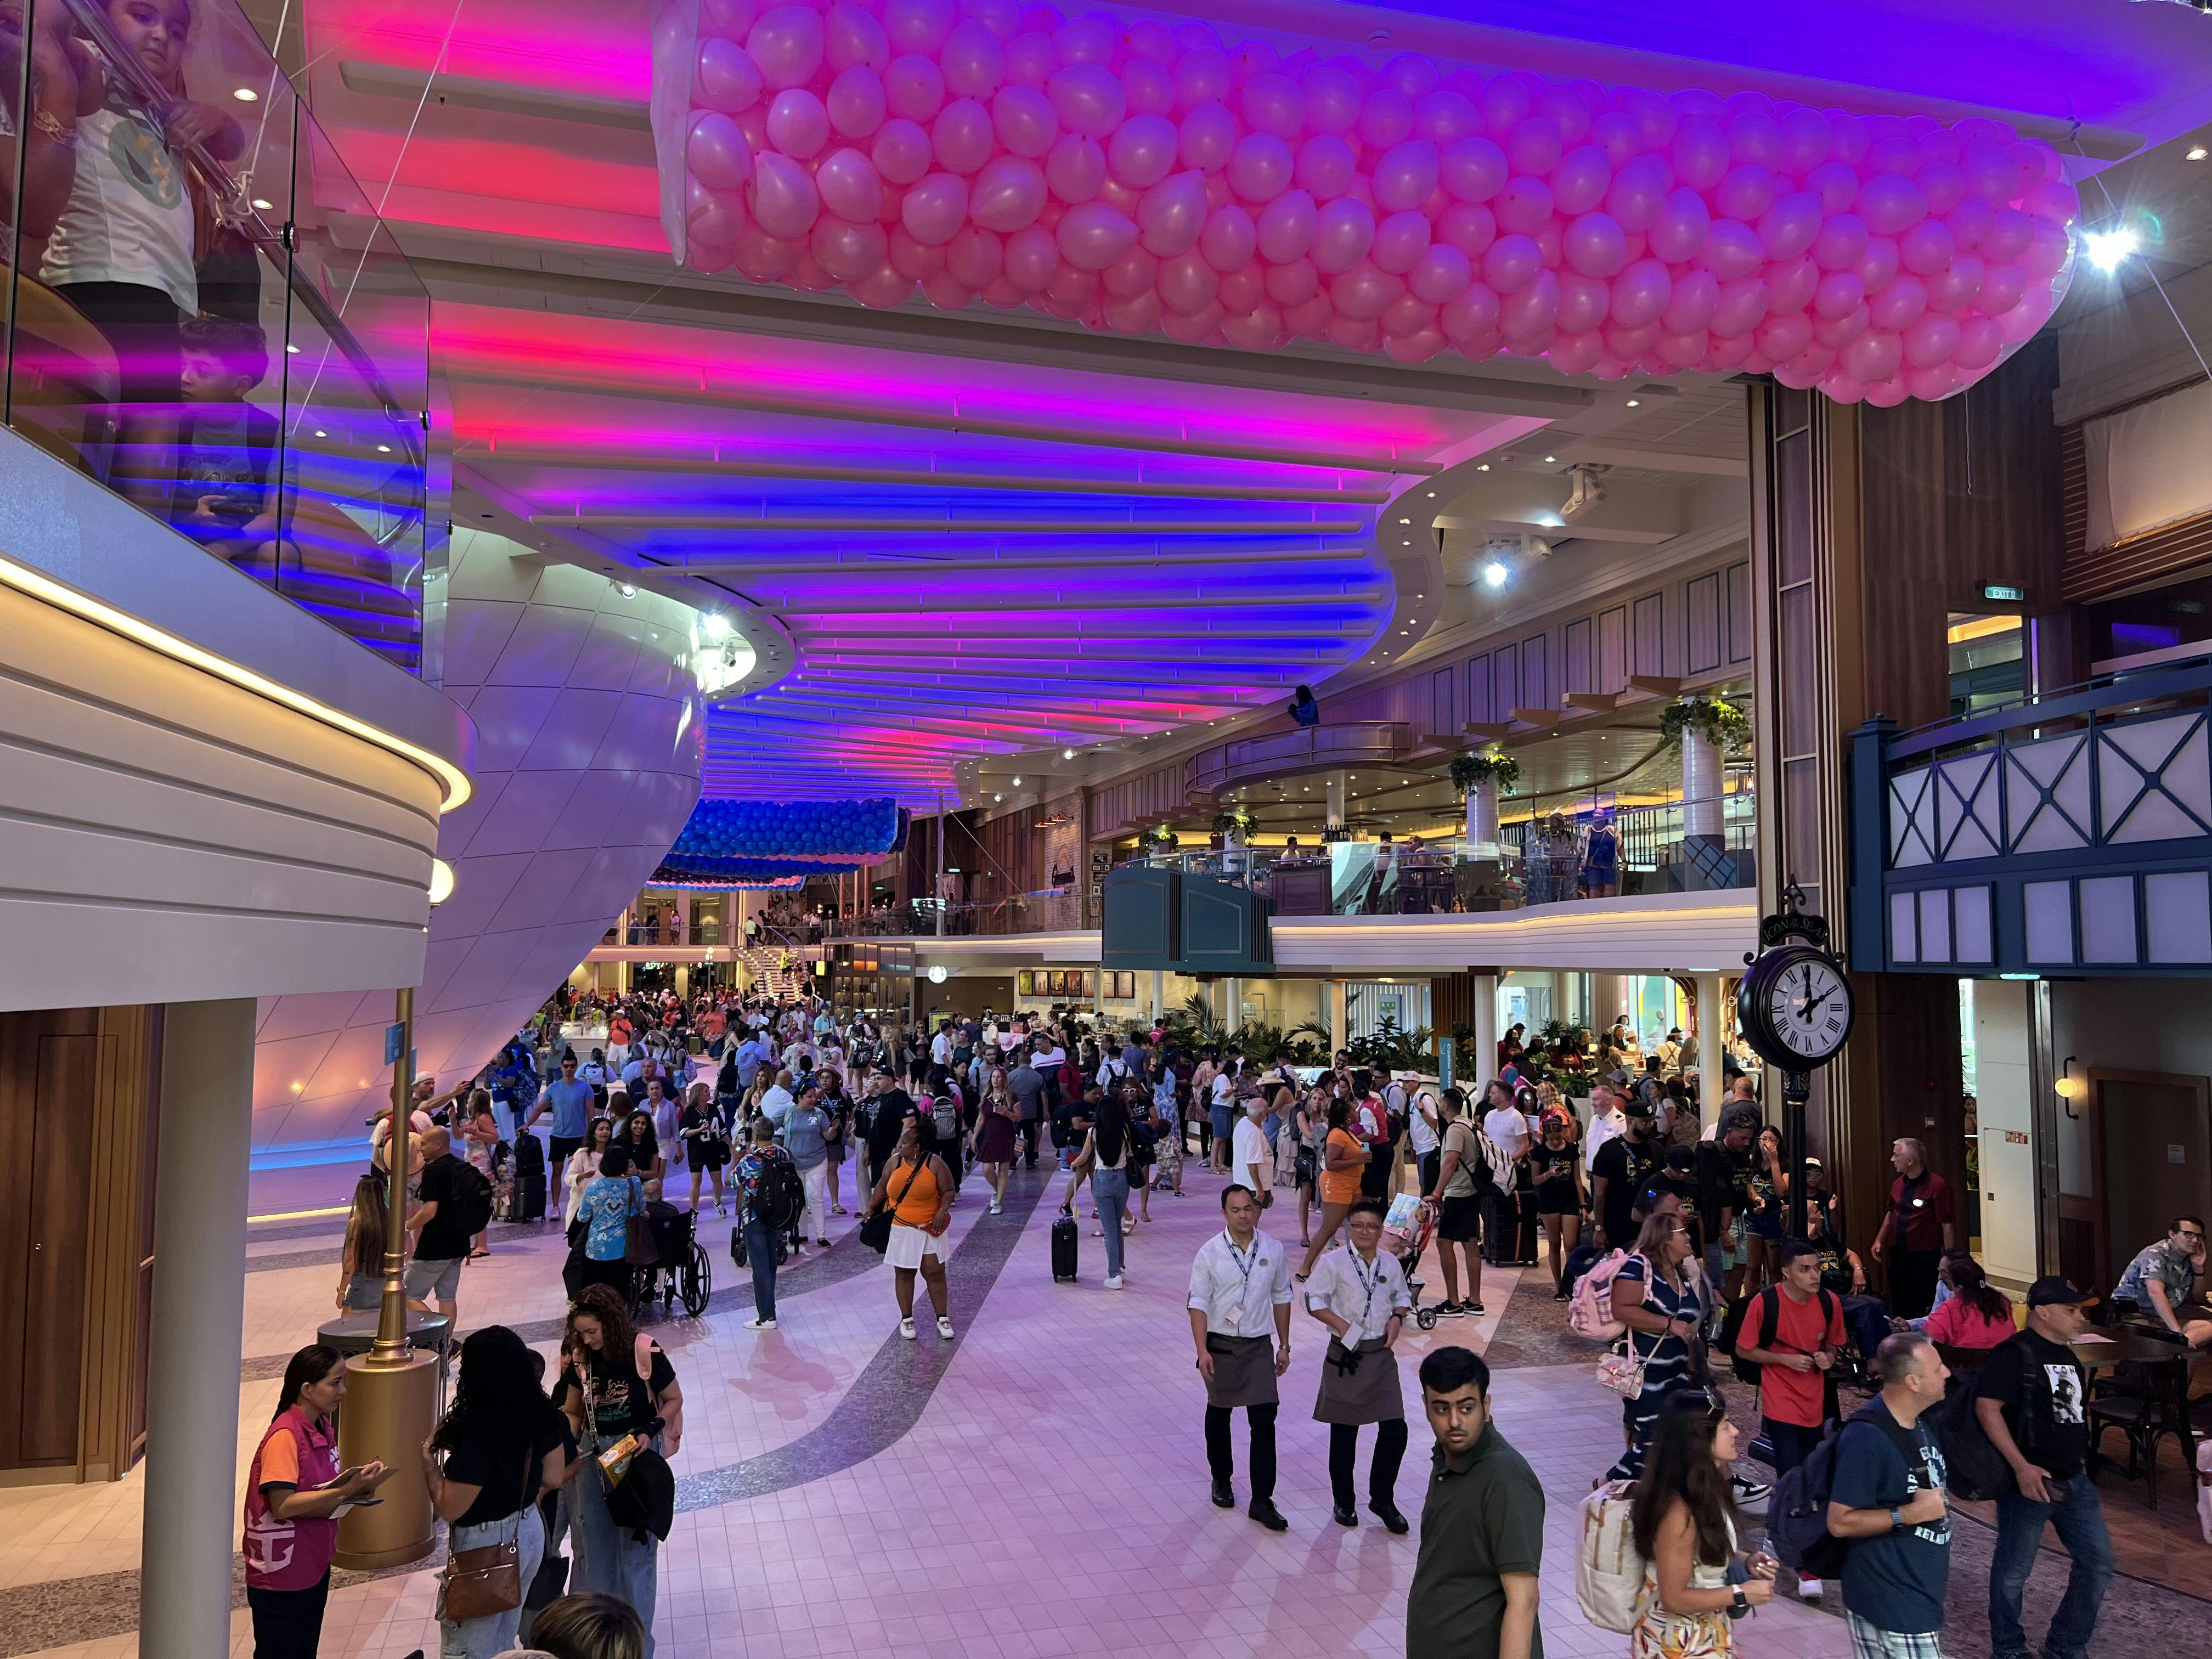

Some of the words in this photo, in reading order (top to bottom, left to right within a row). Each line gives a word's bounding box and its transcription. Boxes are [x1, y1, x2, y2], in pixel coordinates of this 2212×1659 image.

[1763, 919, 1788, 941] ICON
[1800, 918, 1826, 939] SEAS
[2045, 1365, 2075, 1375] ICON
